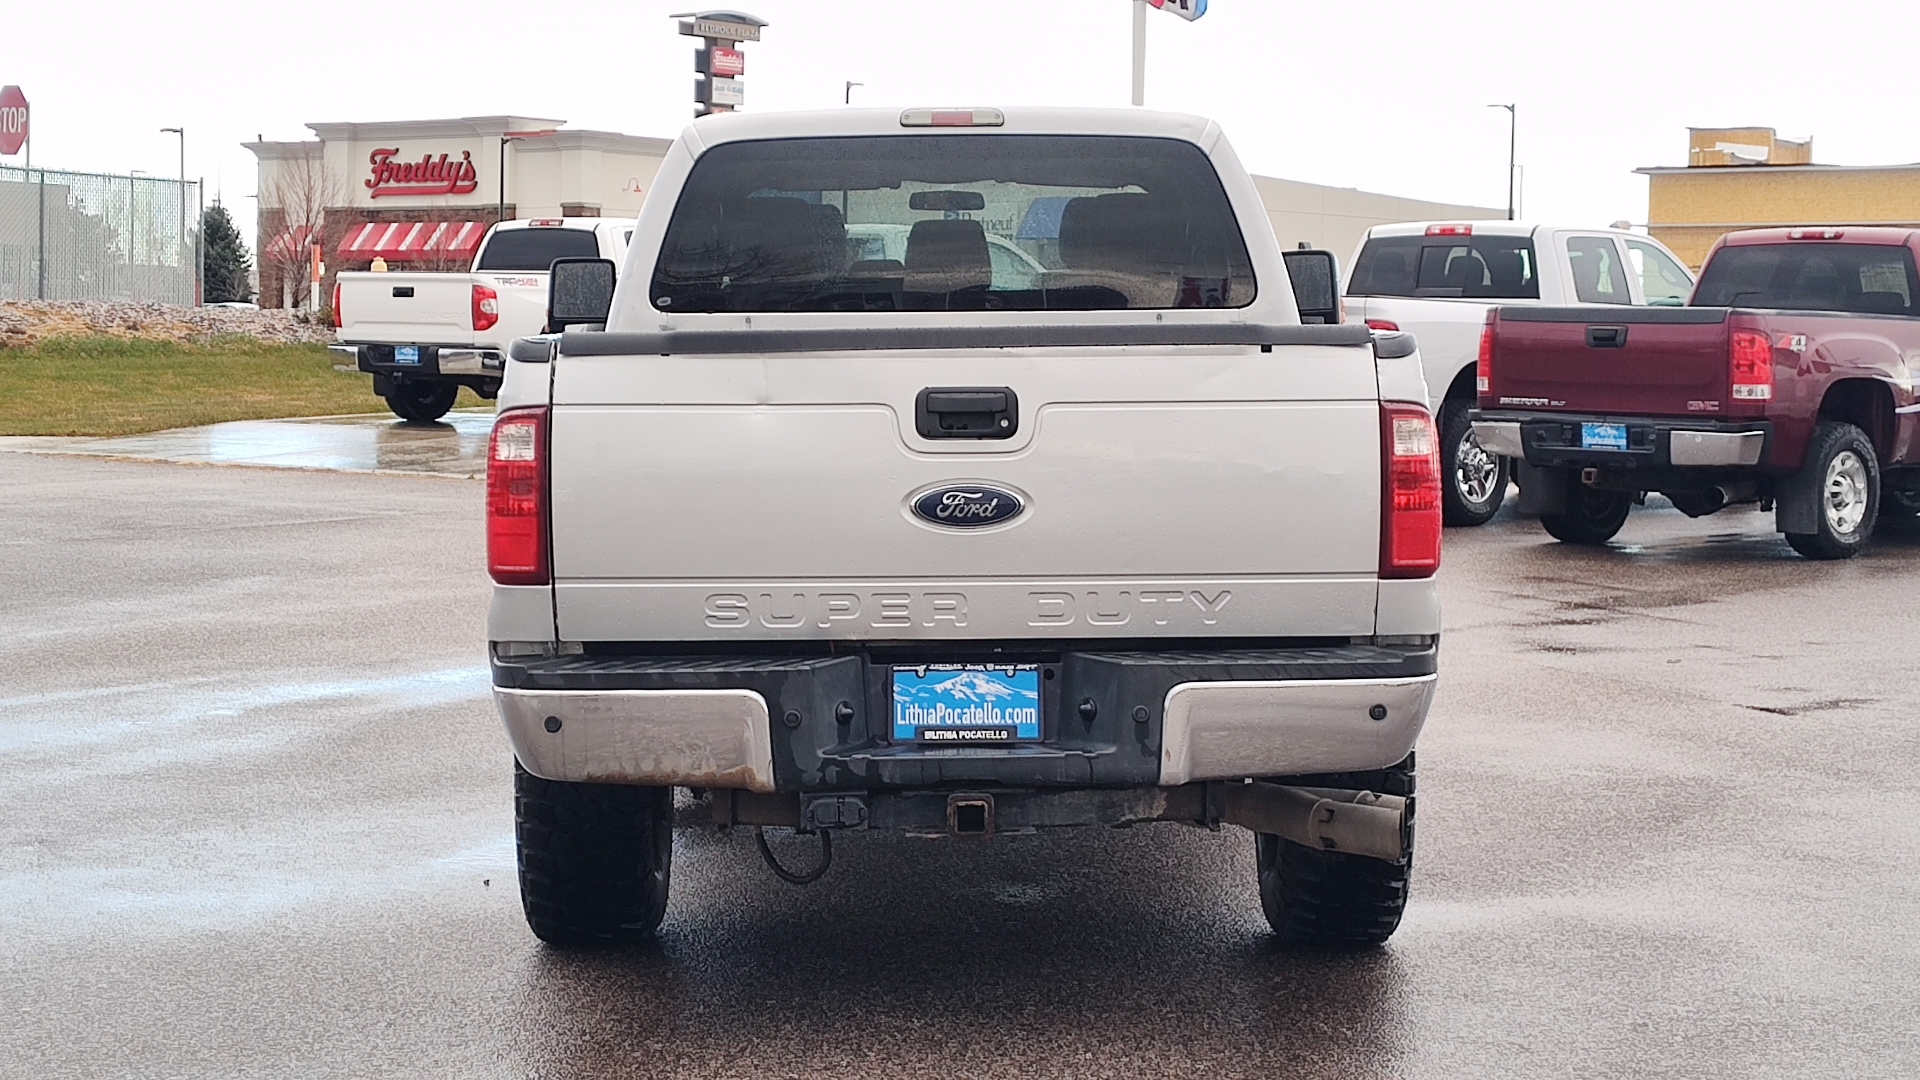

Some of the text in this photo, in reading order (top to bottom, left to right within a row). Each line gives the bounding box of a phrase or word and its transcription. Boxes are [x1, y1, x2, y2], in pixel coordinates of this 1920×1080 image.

[737, 29, 759, 38] PLAZA
[0, 107, 27, 133] TOP
[364, 147, 478, 199] Freddy's
[419, 310, 469, 321] TUNDRA
[1499, 397, 1549, 406] SIERRA
[1687, 400, 1719, 411] GMC
[936, 491, 999, 518] Ford
[704, 590, 1232, 629] SUPER DUTY
[896, 702, 1036, 725] LithiaPocatello.com
[958, 730, 1008, 740] POCATELLO
